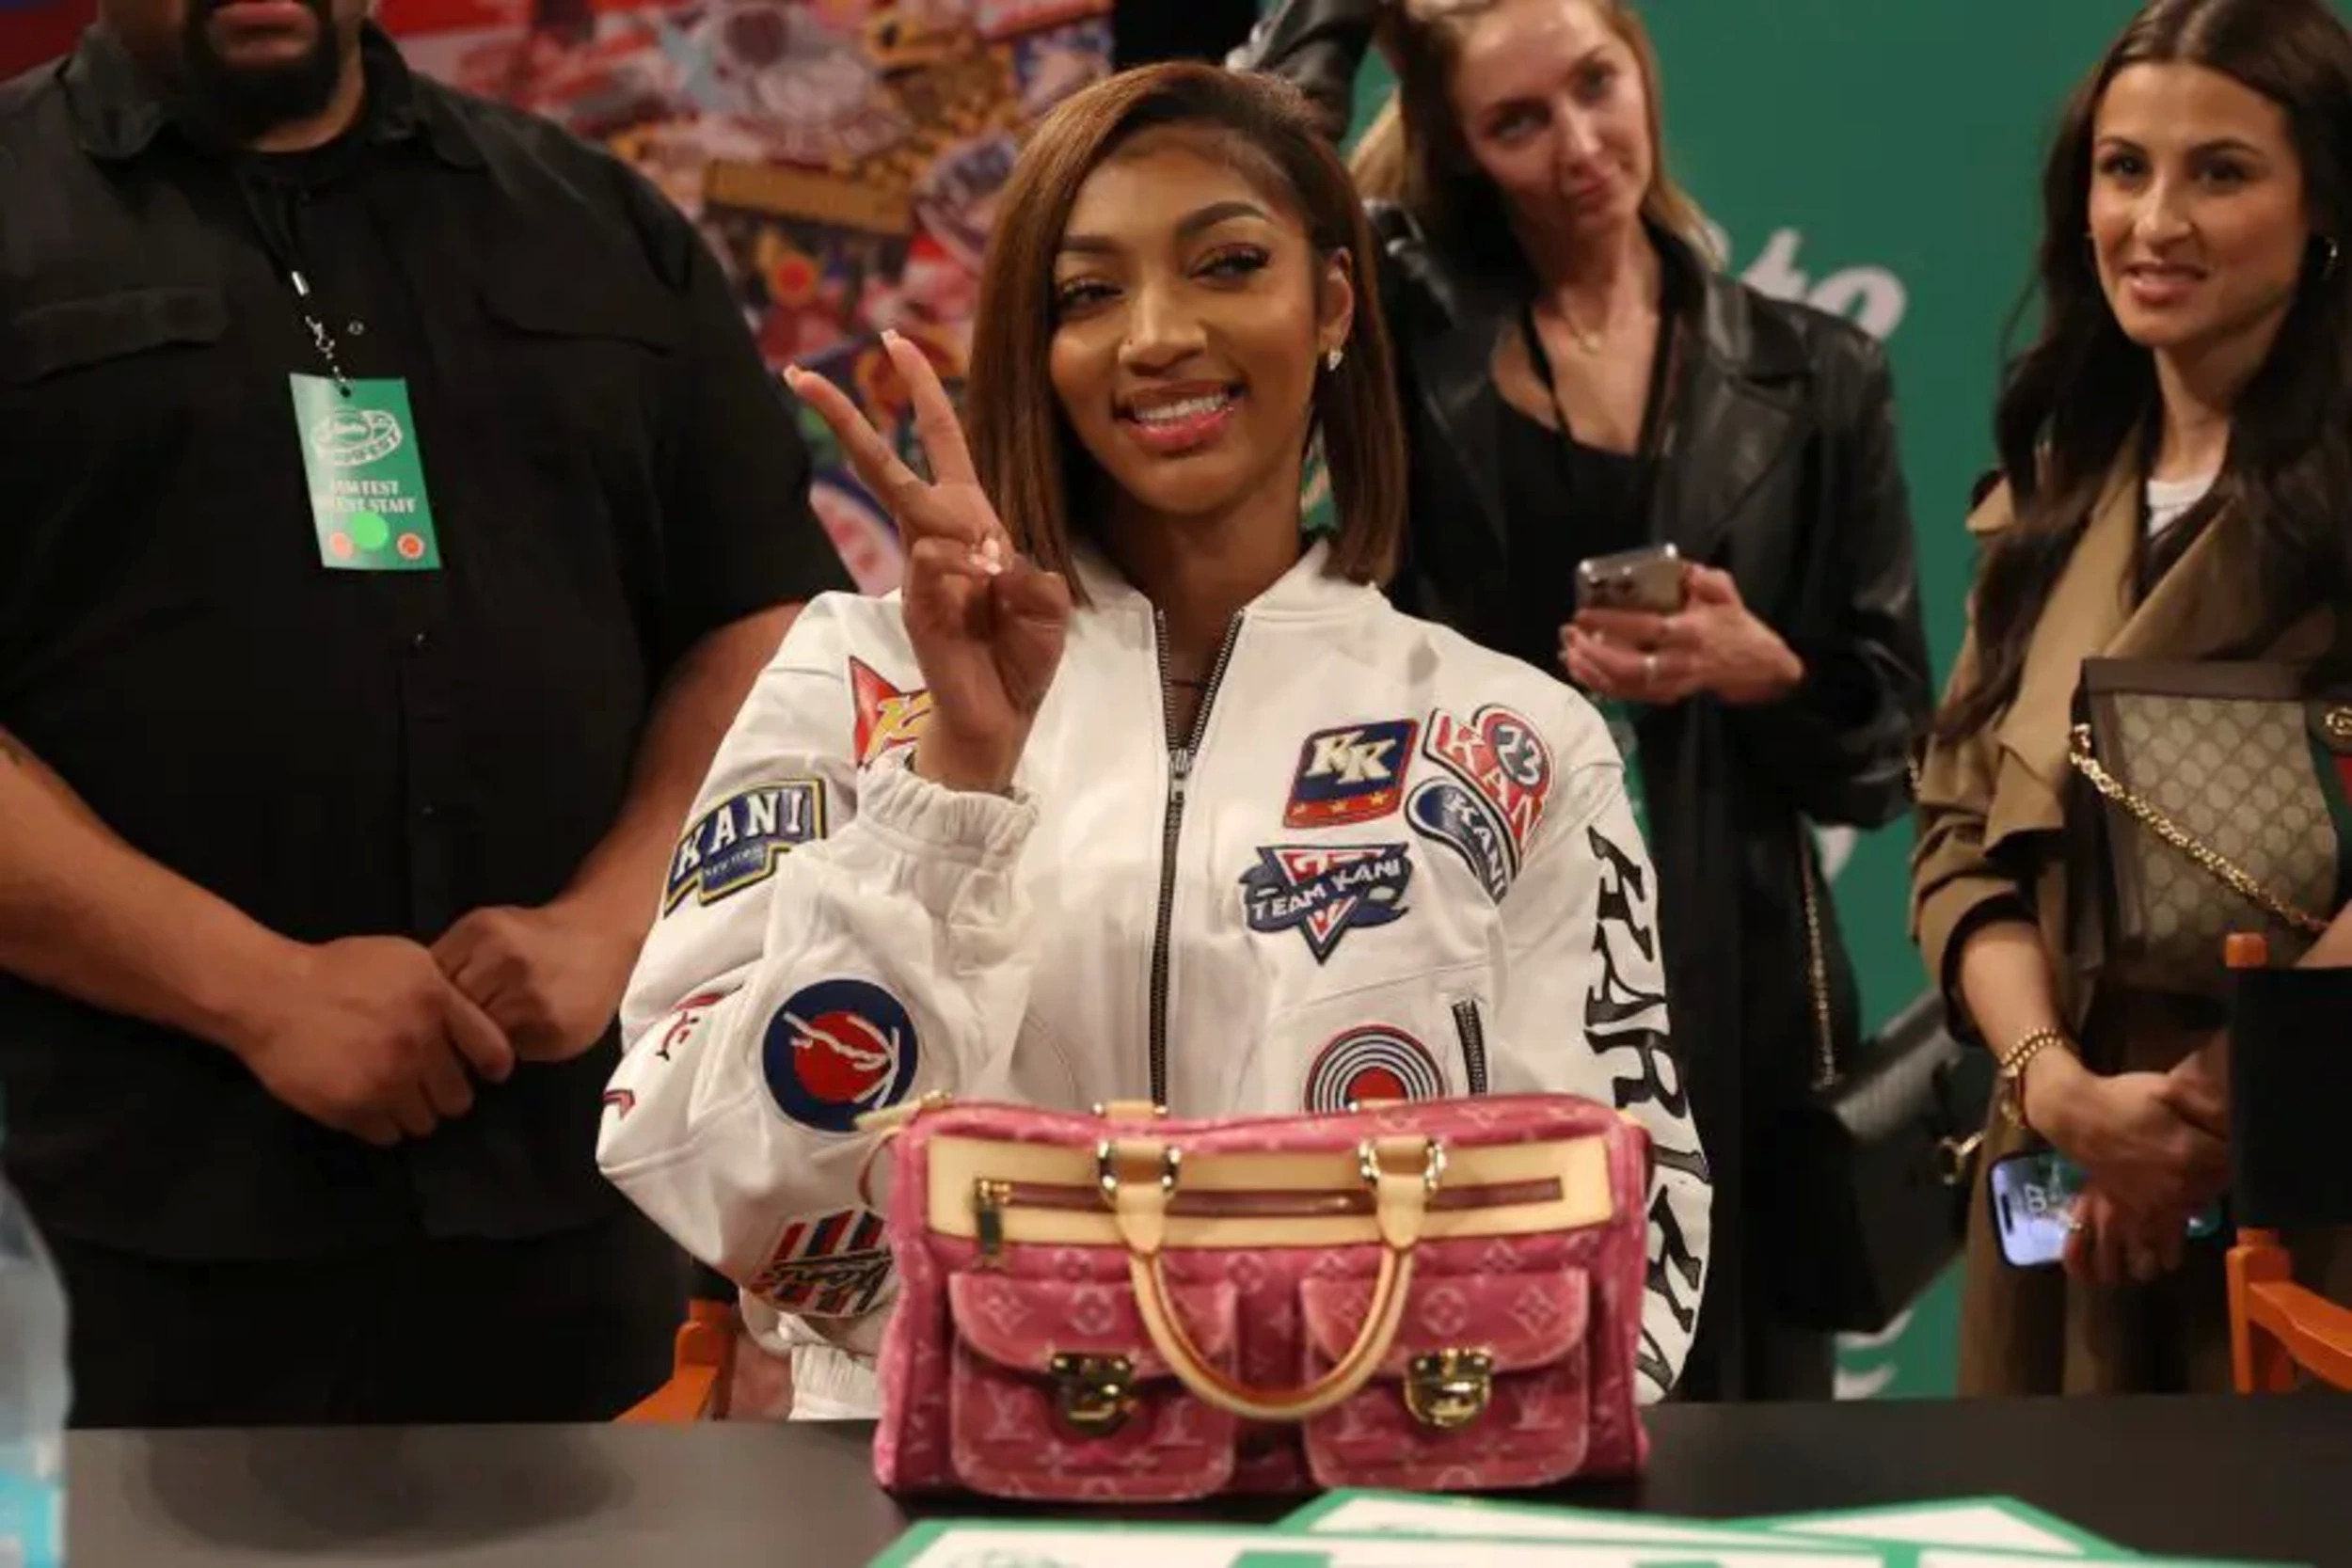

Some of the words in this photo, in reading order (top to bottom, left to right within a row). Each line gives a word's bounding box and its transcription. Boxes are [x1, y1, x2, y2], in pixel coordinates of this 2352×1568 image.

[1304, 730, 1396, 784] KK
[674, 788, 804, 879] KANI
[1443, 792, 1505, 894] KANI
[1251, 882, 1327, 921] TEAM
[1330, 859, 1402, 892] KANI
